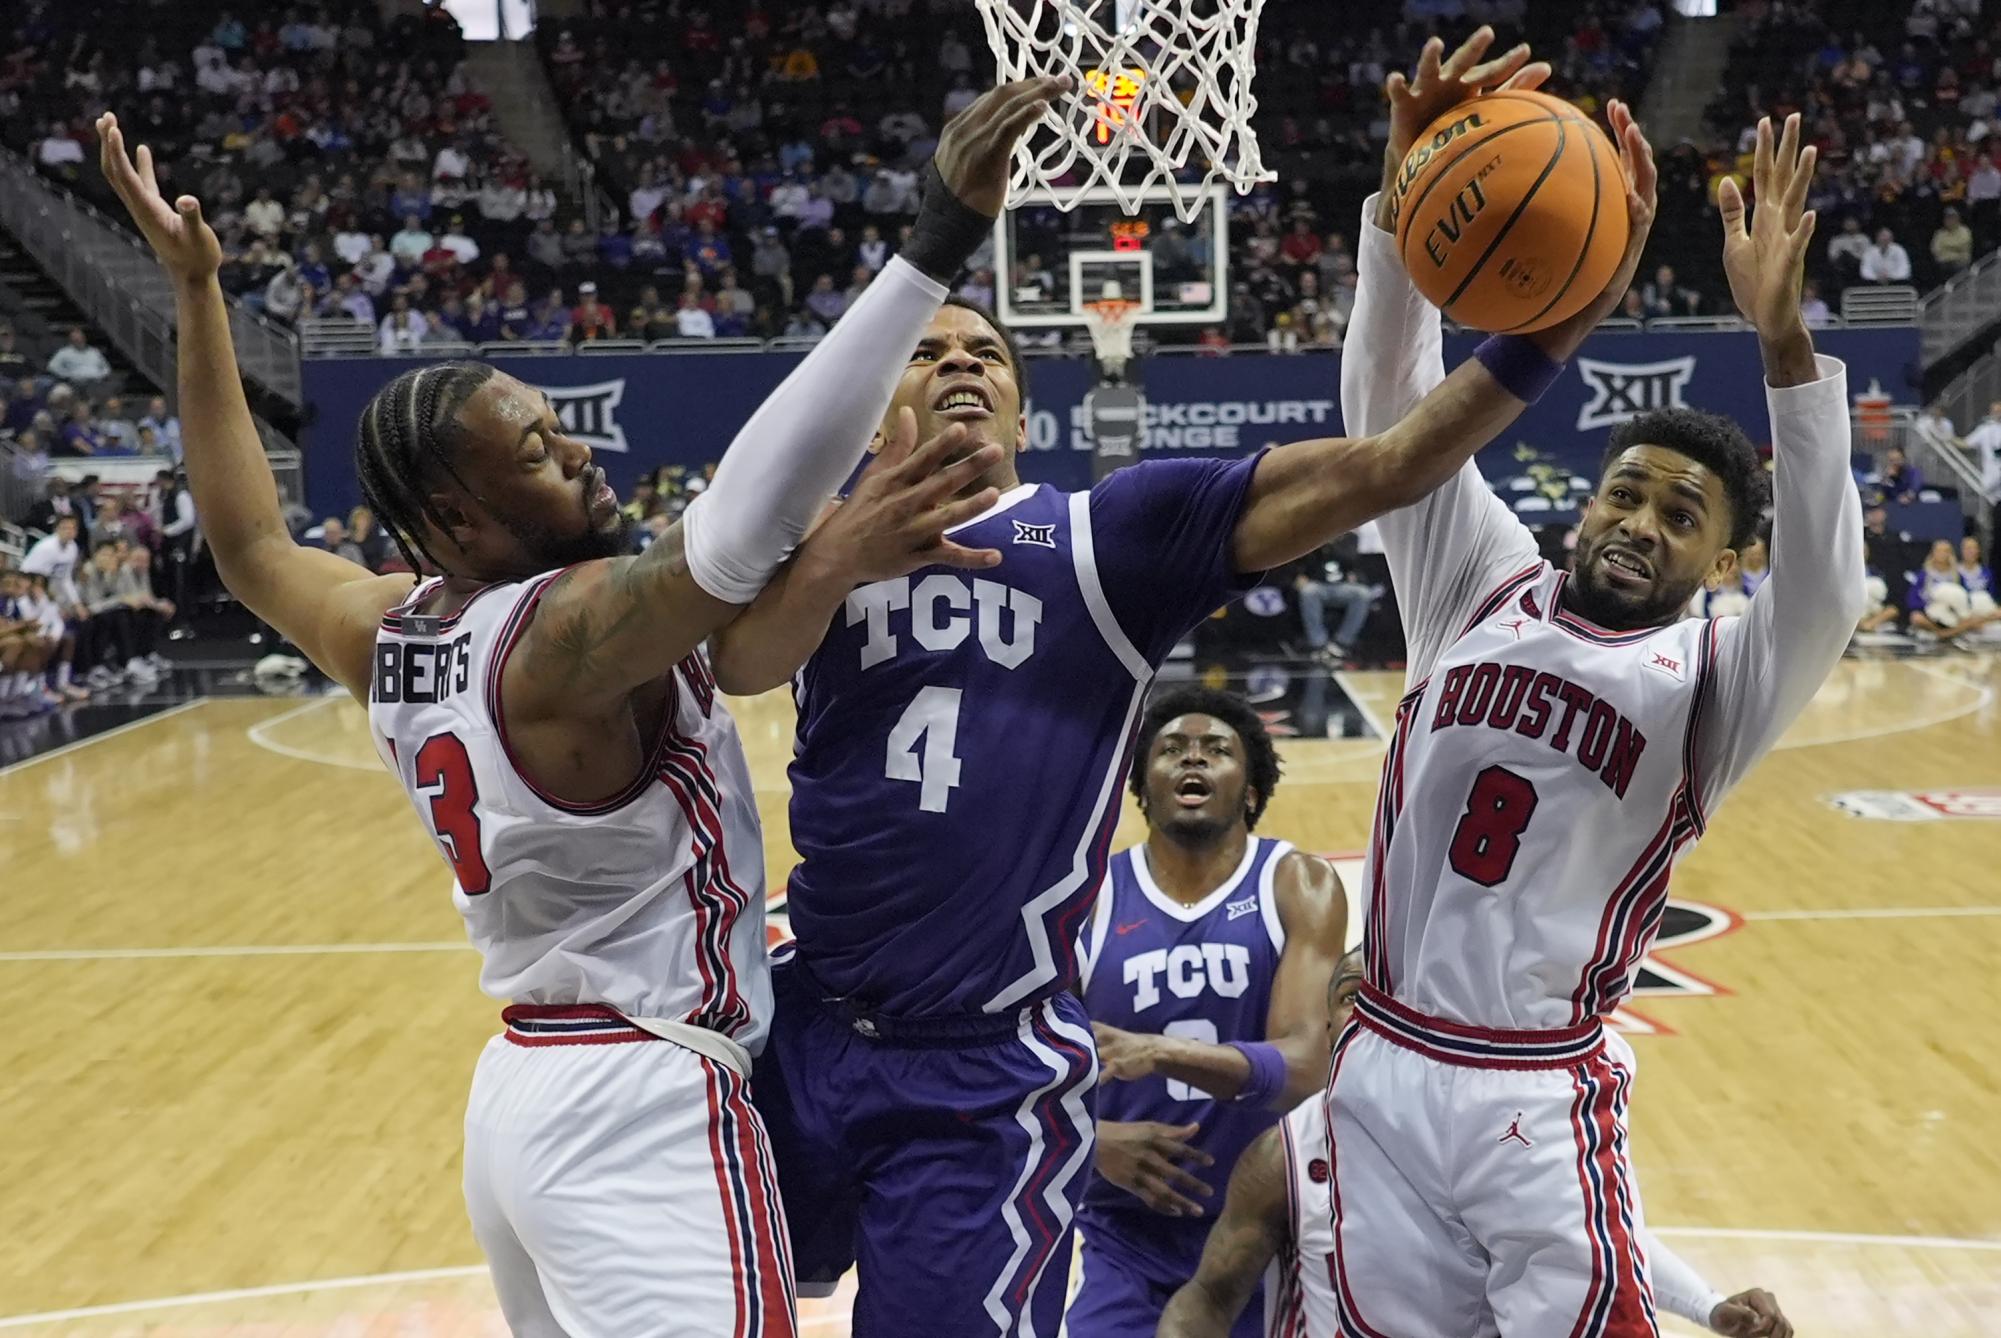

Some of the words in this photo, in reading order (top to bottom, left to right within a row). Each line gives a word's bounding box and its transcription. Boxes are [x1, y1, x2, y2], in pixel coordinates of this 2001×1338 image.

[1425, 179, 1486, 268] EVO
[373, 631, 472, 704] BERTS
[846, 574, 1043, 671] TCU
[885, 685, 963, 813] 4
[1431, 662, 1647, 800] HOUSTON
[1448, 763, 1539, 888] 8
[1123, 943, 1250, 1013] TCU
